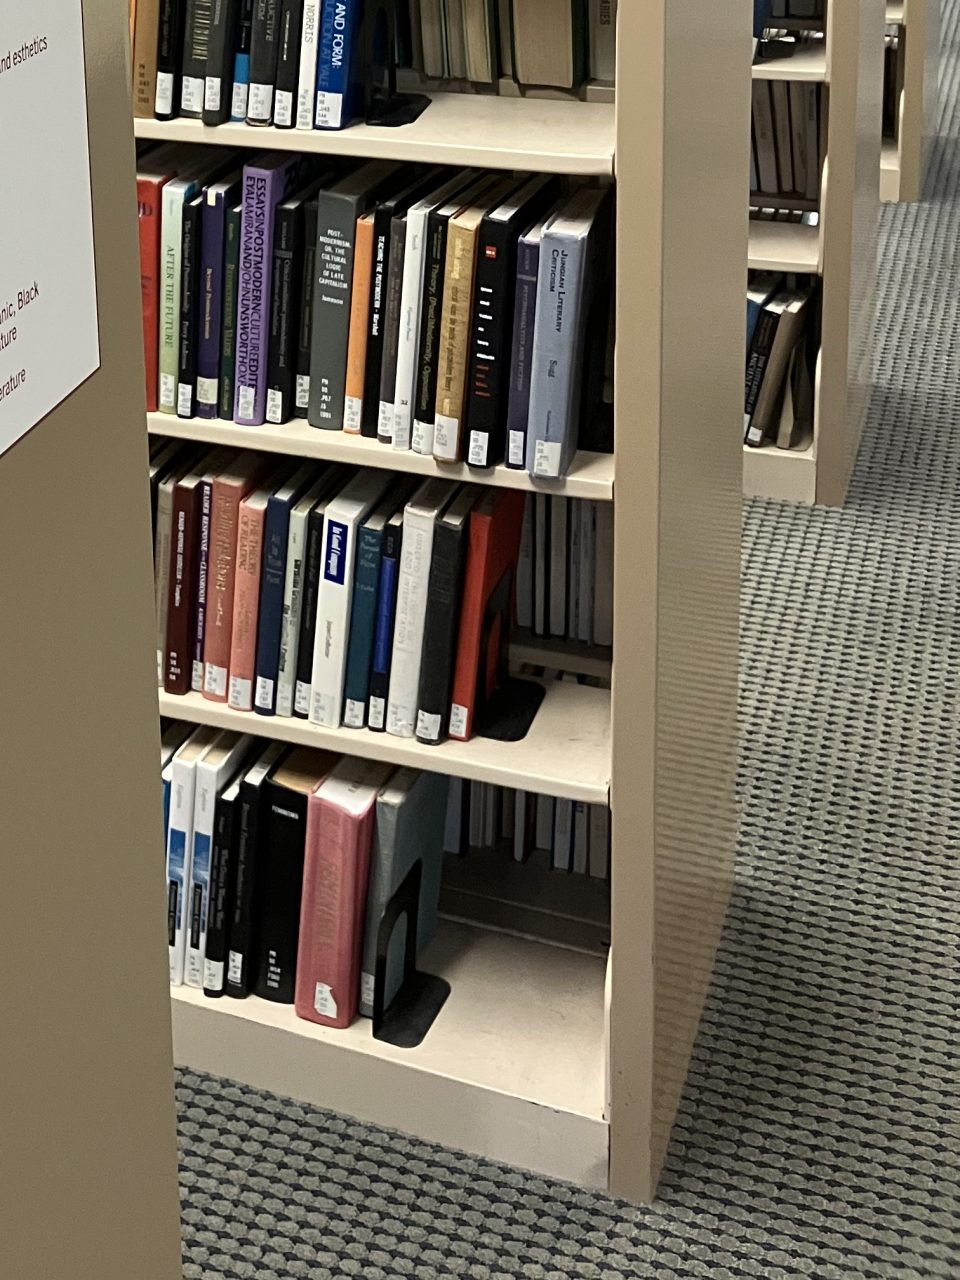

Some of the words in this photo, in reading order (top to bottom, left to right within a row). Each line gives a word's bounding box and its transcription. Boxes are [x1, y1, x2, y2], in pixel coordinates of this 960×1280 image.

[303, 4, 316, 44] NORRIS
[333, 2, 347, 30] AND
[12, 34, 48, 69] esthetics
[331, 34, 344, 69] FORM:
[318, 63, 330, 88] YALE
[165, 245, 176, 280] AFTER
[548, 249, 560, 293] CRITICISM
[558, 250, 568, 289] JUNGIAN
[17, 282, 40, 310] Black
[165, 284, 175, 304] THE
[164, 306, 175, 349] FUTURE
[555, 291, 565, 333] LITERARY
